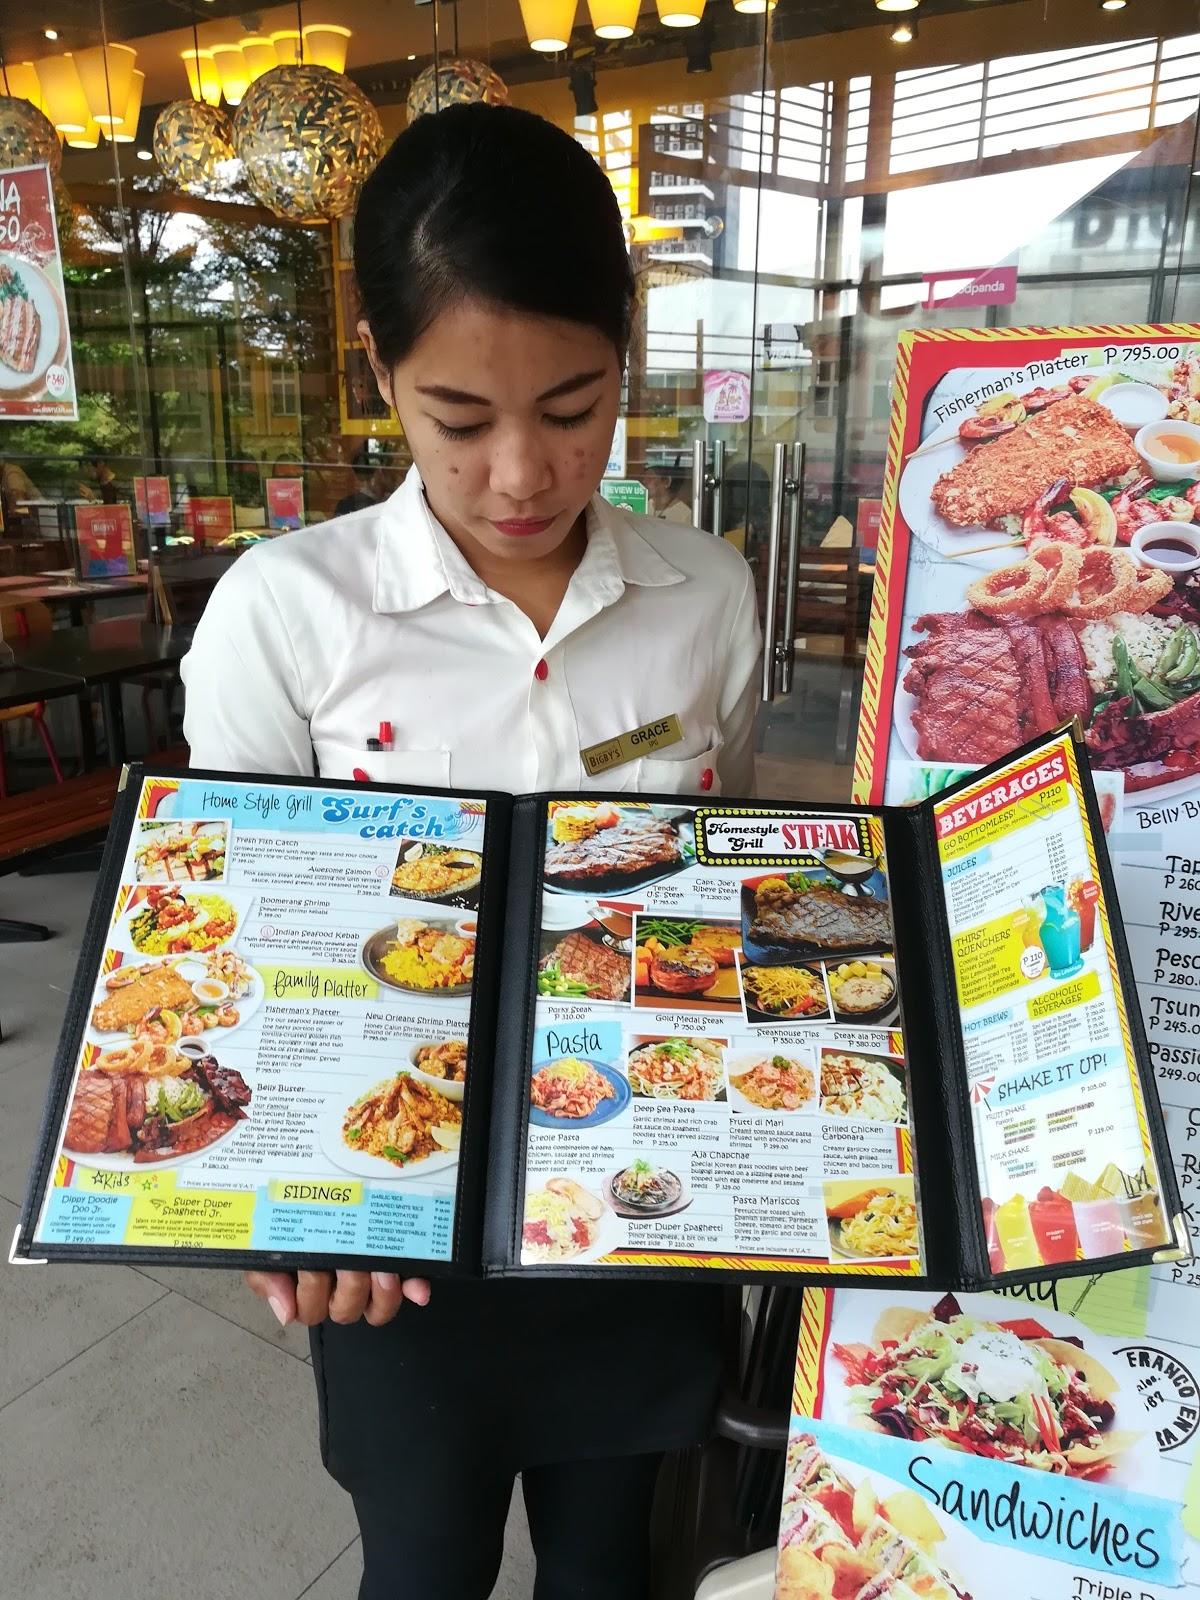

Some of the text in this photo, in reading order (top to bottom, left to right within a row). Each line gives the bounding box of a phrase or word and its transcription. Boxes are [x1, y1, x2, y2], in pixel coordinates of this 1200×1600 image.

[933, 372, 1024, 425] Fisherman's
[1027, 352, 1089, 382] Platter
[1122, 346, 1179, 361] 795.00
[630, 721, 671, 745] GRACE
[588, 748, 621, 768] BIGBY'S
[938, 756, 1065, 835] BEVERAGES
[202, 791, 427, 823] Home Style Grill Surf's
[1136, 800, 1200, 829] Belly B
[359, 816, 445, 839] catch
[236, 836, 256, 844] Fresh
[275, 838, 299, 847] Catch
[707, 822, 860, 851] Homestyle STEAK
[727, 838, 764, 852] Grill
[943, 839, 957, 851] GO
[308, 865, 372, 876] Awesome Salmon
[947, 856, 977, 878] JUICES
[664, 891, 684, 899] Steak
[718, 887, 739, 895] Steak
[260, 897, 330, 907] Boomerang Shrimp
[275, 928, 360, 940] Indian Seafood Kebab
[955, 928, 987, 946] THIRST
[957, 929, 1011, 957] QUENCHERS
[1168, 973, 1200, 986] 280.
[1032, 983, 1084, 1007] ALCOHOLIC
[265, 1006, 340, 1016] Fisherman's Platter
[1033, 993, 1083, 1017] BEVERAGES
[385, 1013, 415, 1024] Orleans
[417, 1016, 444, 1026] Shrimp
[655, 1014, 724, 1025] Gold Medal Steak
[964, 1011, 1009, 1032] HOT BREWS
[756, 1028, 819, 1038] Steakhouse Tips
[834, 1032, 856, 1040] Steak
[546, 1028, 602, 1057] Pasta
[1148, 1042, 1200, 1065] Passi
[998, 1053, 1108, 1101] SHAKE IT UP!
[257, 1083, 306, 1093] Belly Buster
[634, 1105, 654, 1113] Deep
[673, 1106, 696, 1114] Pasta
[765, 1119, 784, 1127] Mari
[821, 1125, 884, 1134] Grilled Chicken
[529, 1134, 556, 1142] Creole
[822, 1133, 864, 1141] Carbonara
[709, 1151, 750, 1160] Chapchae
[104, 1171, 130, 1190] Kids
[61, 1196, 118, 1205] Dippy Doodle
[283, 1185, 352, 1203] SIDINGS
[732, 1195, 800, 1205] Pasta Mariscos
[173, 1197, 233, 1209] Super Duper
[162, 1207, 206, 1217] Spaghetti
[628, 1223, 723, 1233] Super Duper Spaghetti
[907, 1455, 1161, 1570] Sandwiches
[1073, 1576, 1132, 1600] Triple
